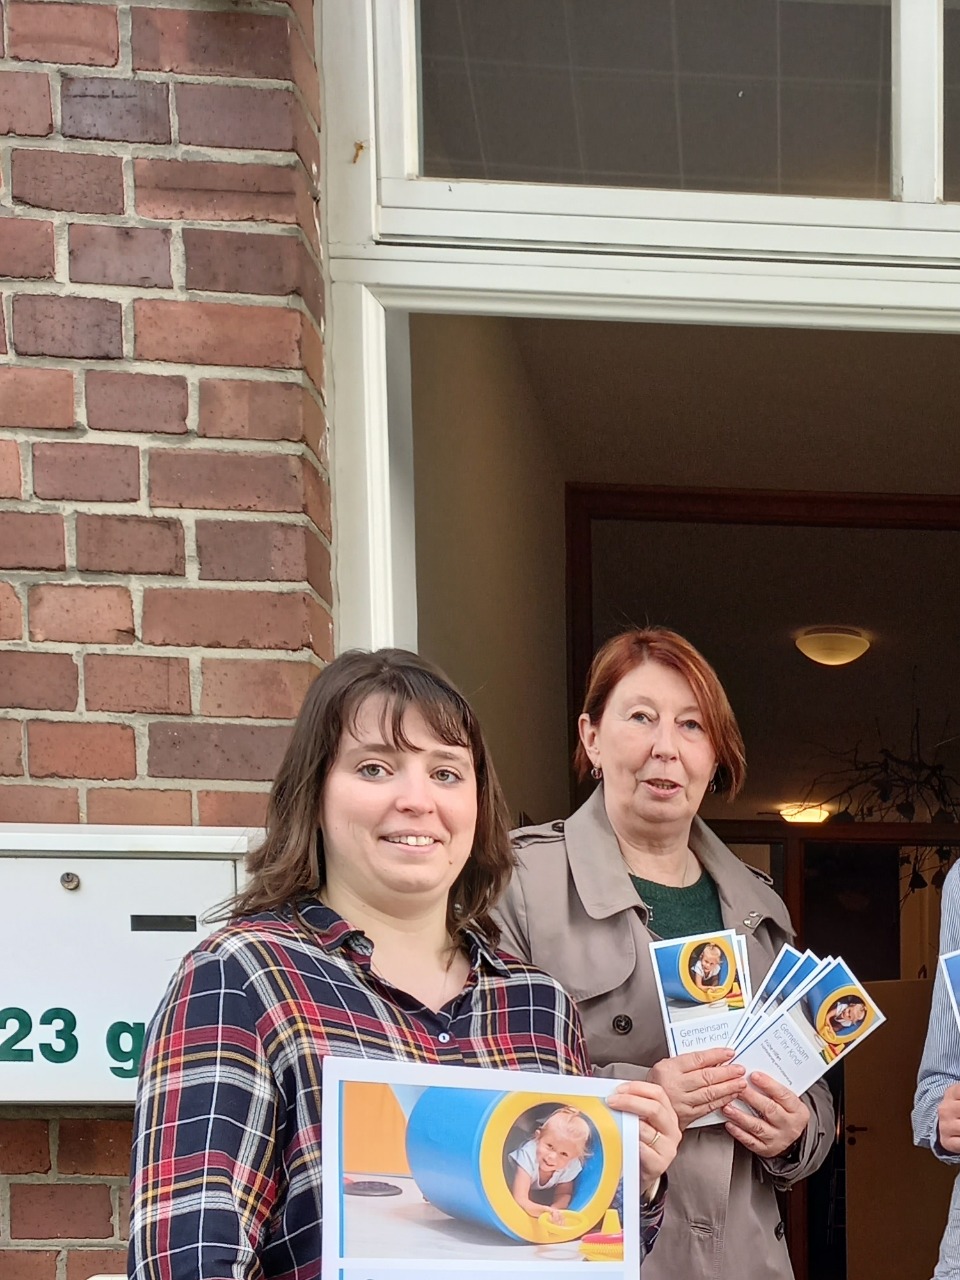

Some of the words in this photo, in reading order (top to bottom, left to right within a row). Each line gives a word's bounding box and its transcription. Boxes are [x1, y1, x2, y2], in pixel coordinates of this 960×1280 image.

[679, 1021, 729, 1038] Gemeinsam
[773, 1029, 784, 1042] für
[0, 1006, 79, 1064] 23
[105, 1020, 146, 1079] g
[681, 1038, 694, 1048] für
[696, 1036, 708, 1046] Ihr
[709, 1031, 730, 1042] Kind!
[779, 1022, 810, 1061] Gemeinsam
